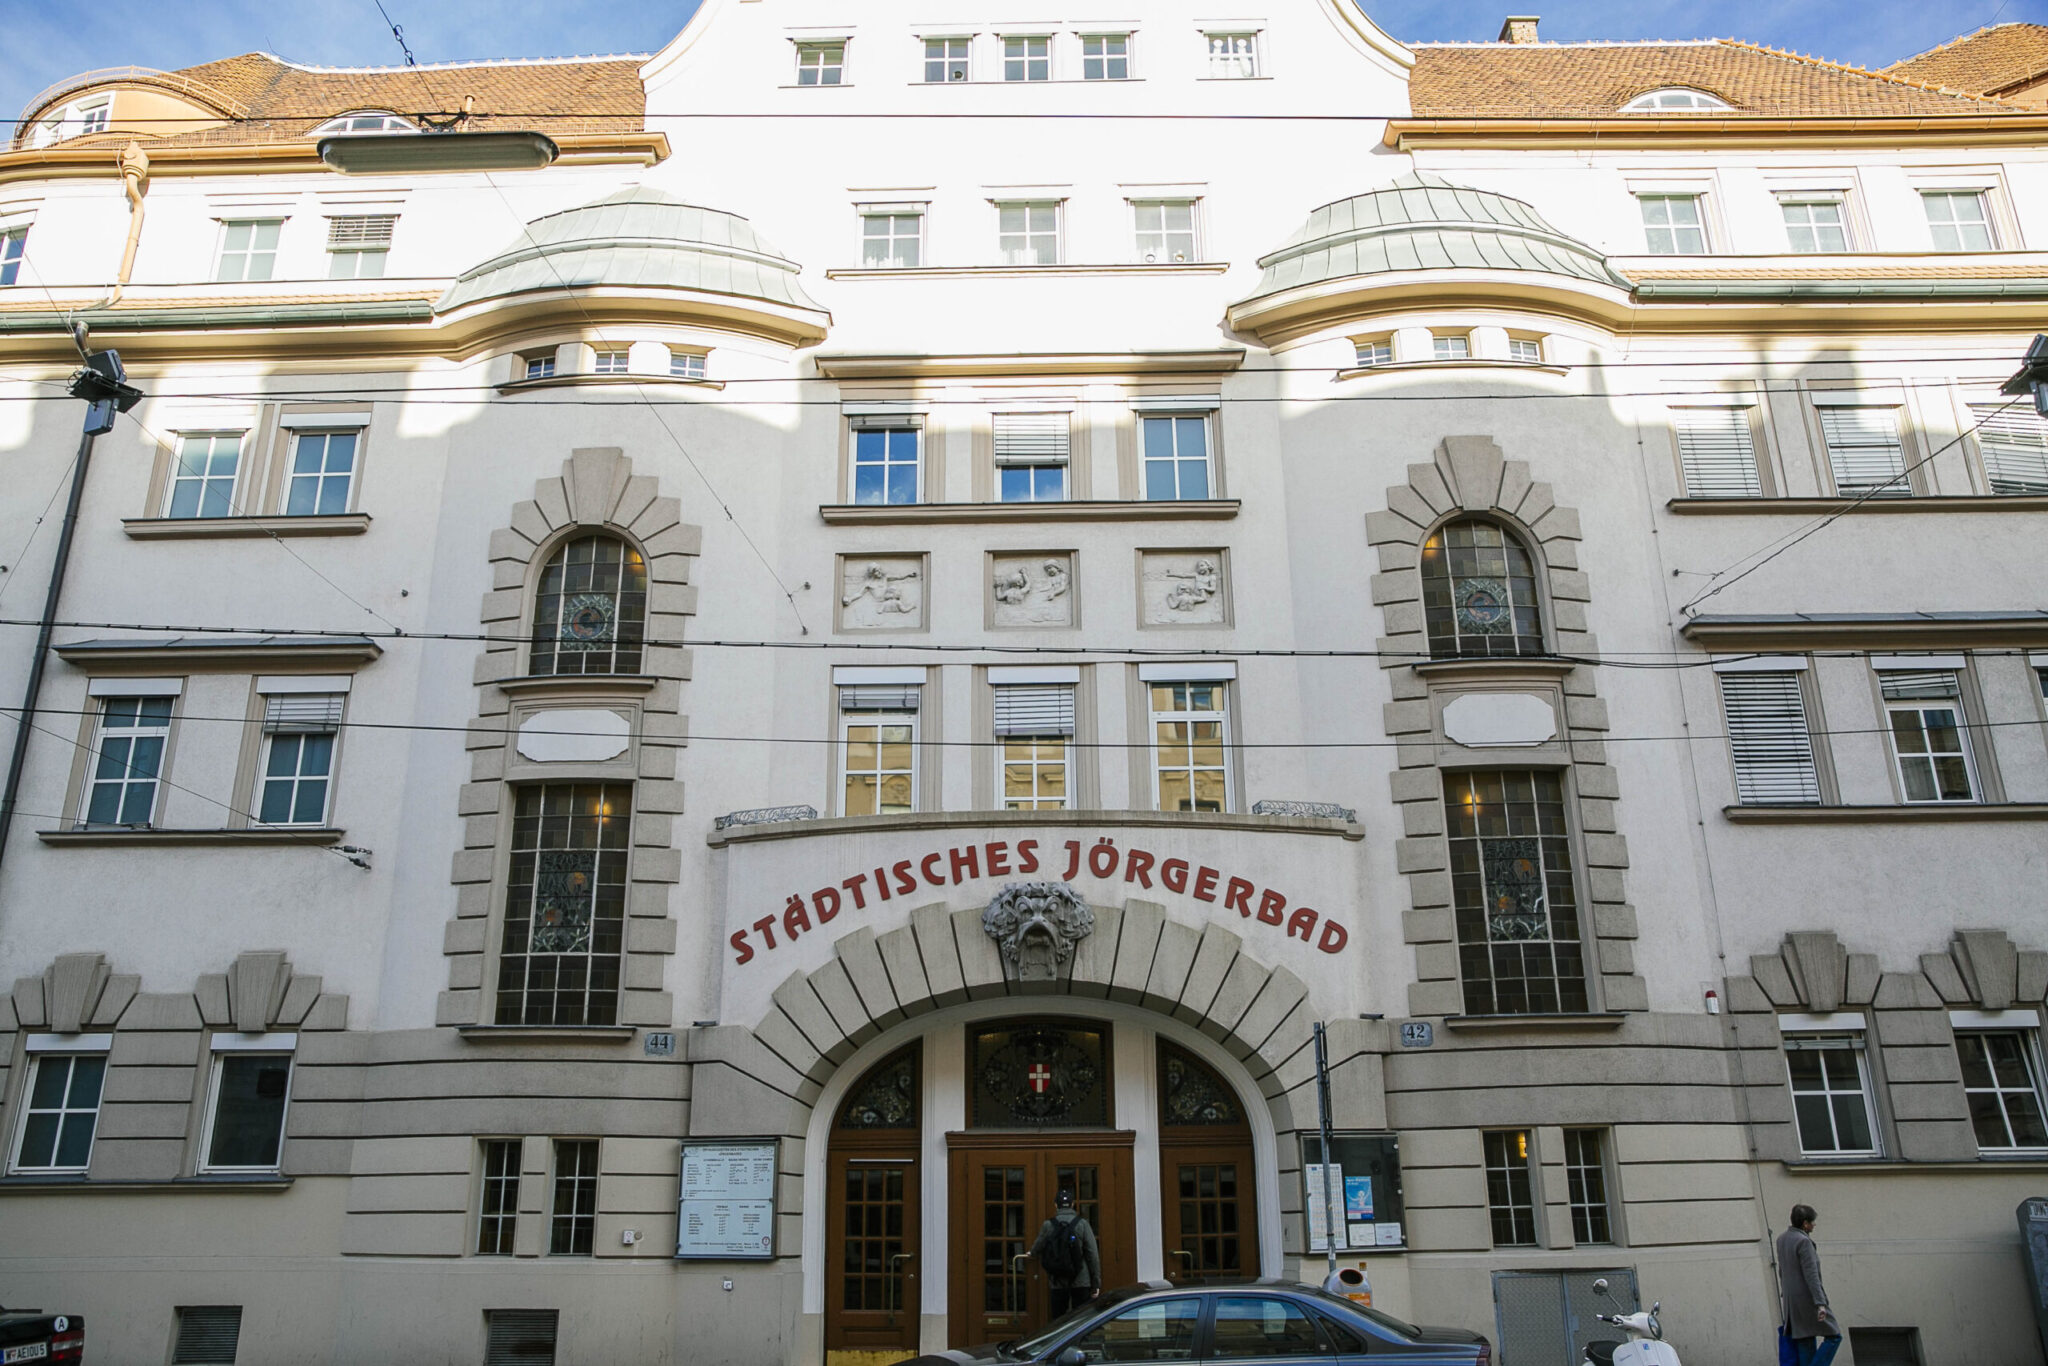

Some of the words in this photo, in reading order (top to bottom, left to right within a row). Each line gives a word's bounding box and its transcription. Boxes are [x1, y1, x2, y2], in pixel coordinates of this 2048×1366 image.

[730, 840, 1039, 964] STÄDTISCHES
[1062, 836, 1349, 955] JÖRGERBAD
[1406, 1024, 1425, 1039] 42
[650, 1035, 668, 1049] 44
[58, 1318, 65, 1329] A
